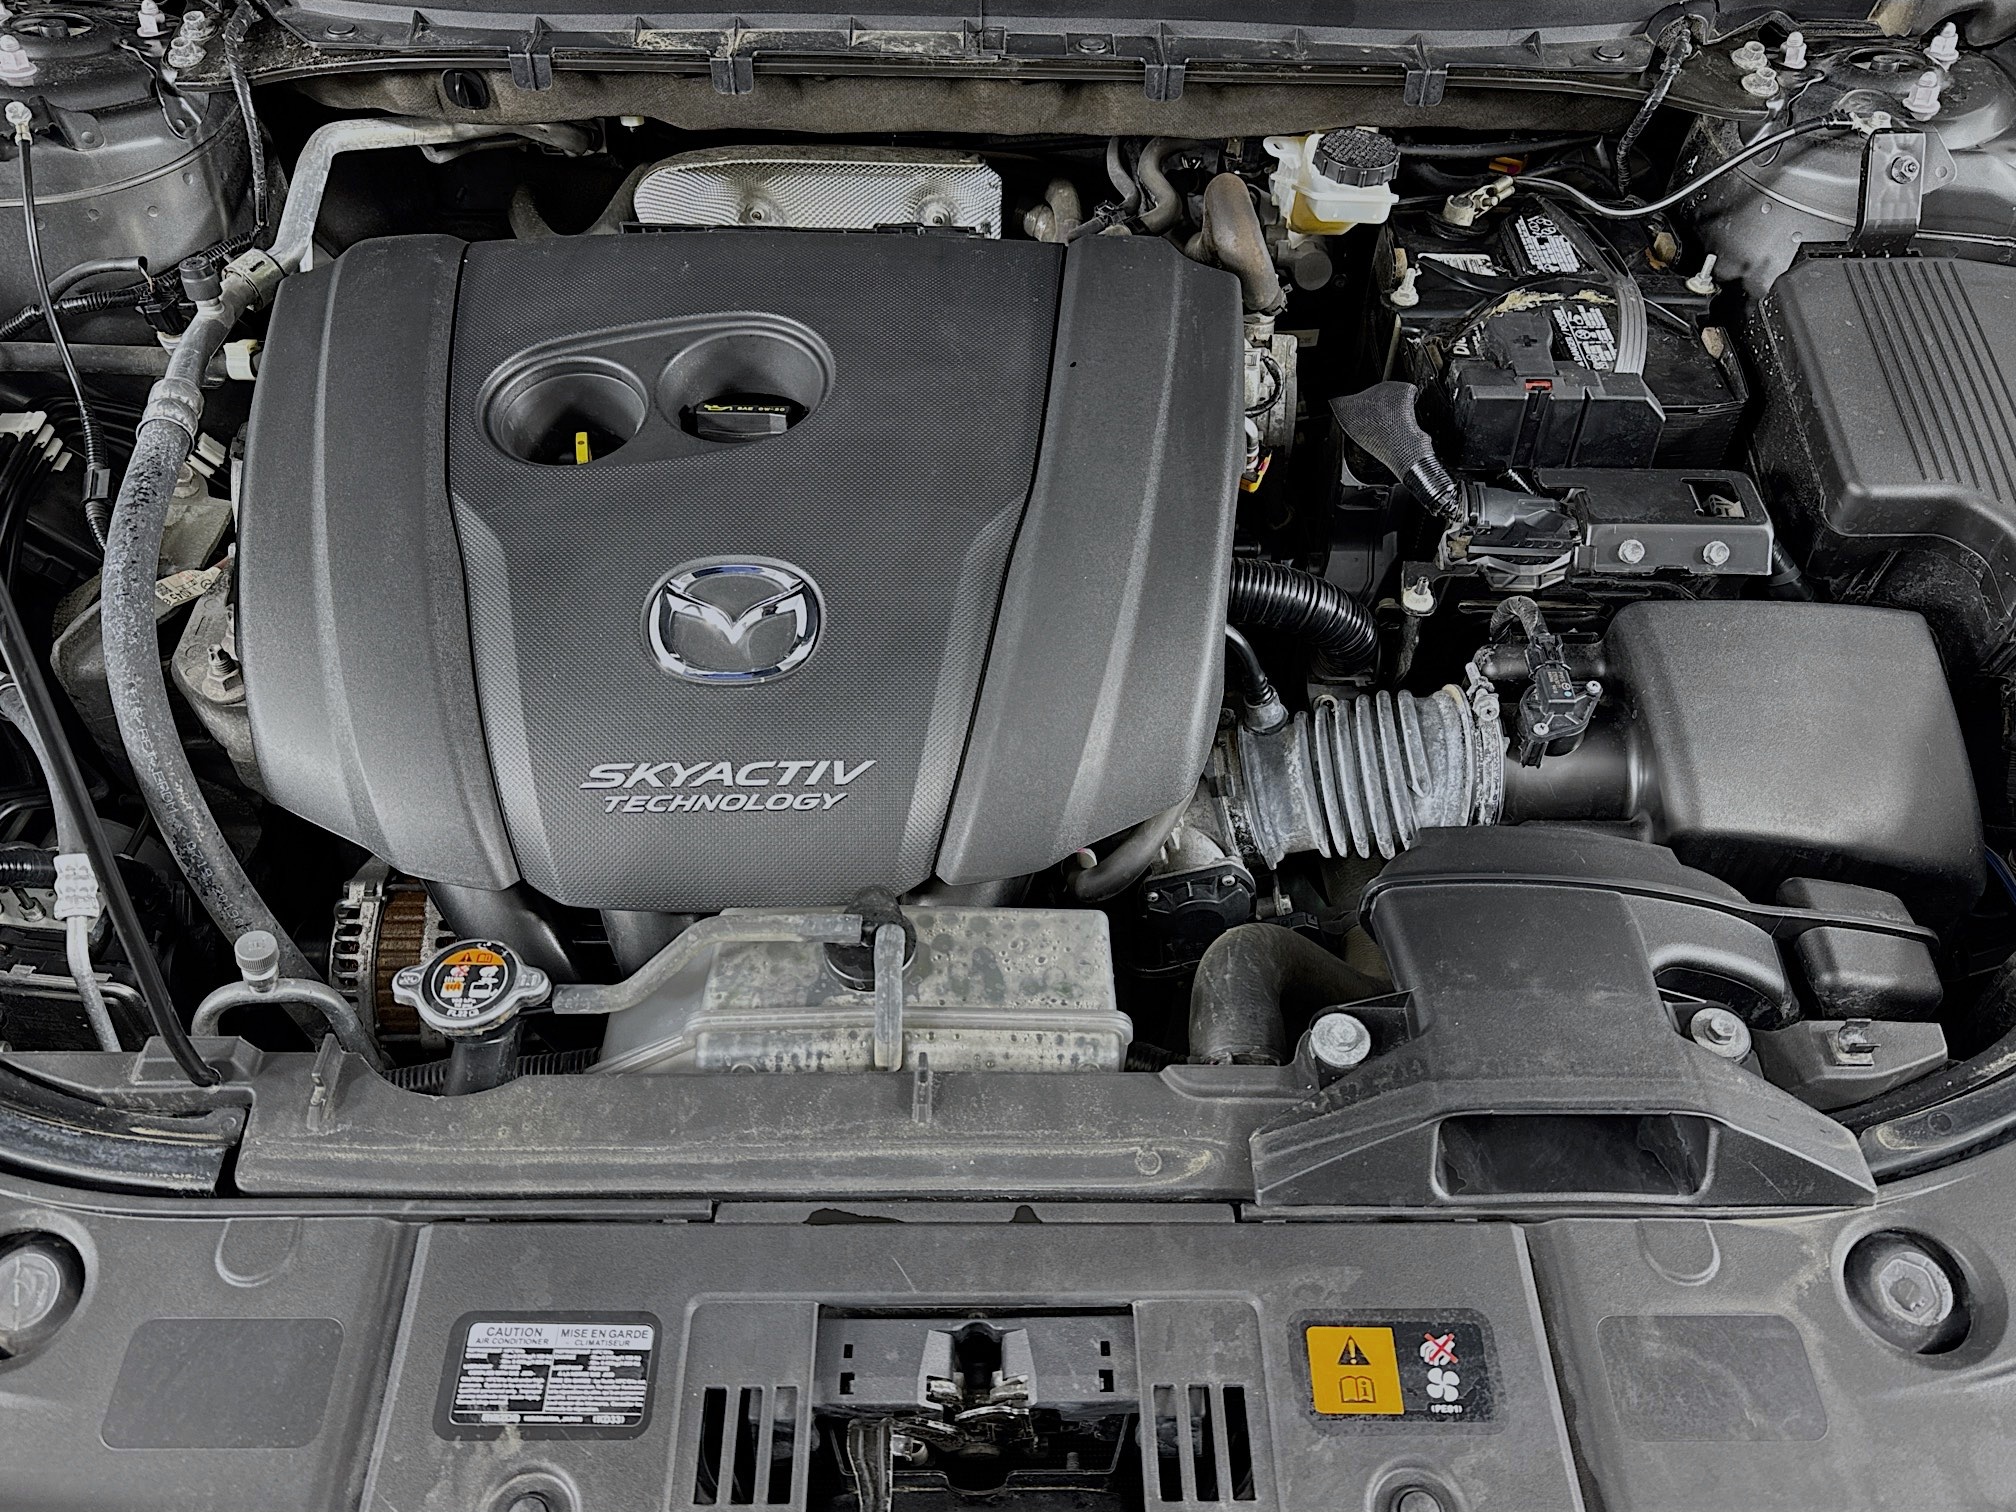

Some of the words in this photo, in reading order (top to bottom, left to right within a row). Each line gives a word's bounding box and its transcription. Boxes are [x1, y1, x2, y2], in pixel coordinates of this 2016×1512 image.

[580, 760, 877, 789] SKYACTIV
[604, 793, 848, 813] TECHNOLOGY
[486, 1327, 543, 1337] CAUTION
[561, 1328, 588, 1338] MISE
[591, 1329, 607, 1338] EN
[609, 1329, 649, 1339] GARDE
[574, 1339, 631, 1347] CLIMATISEUR
